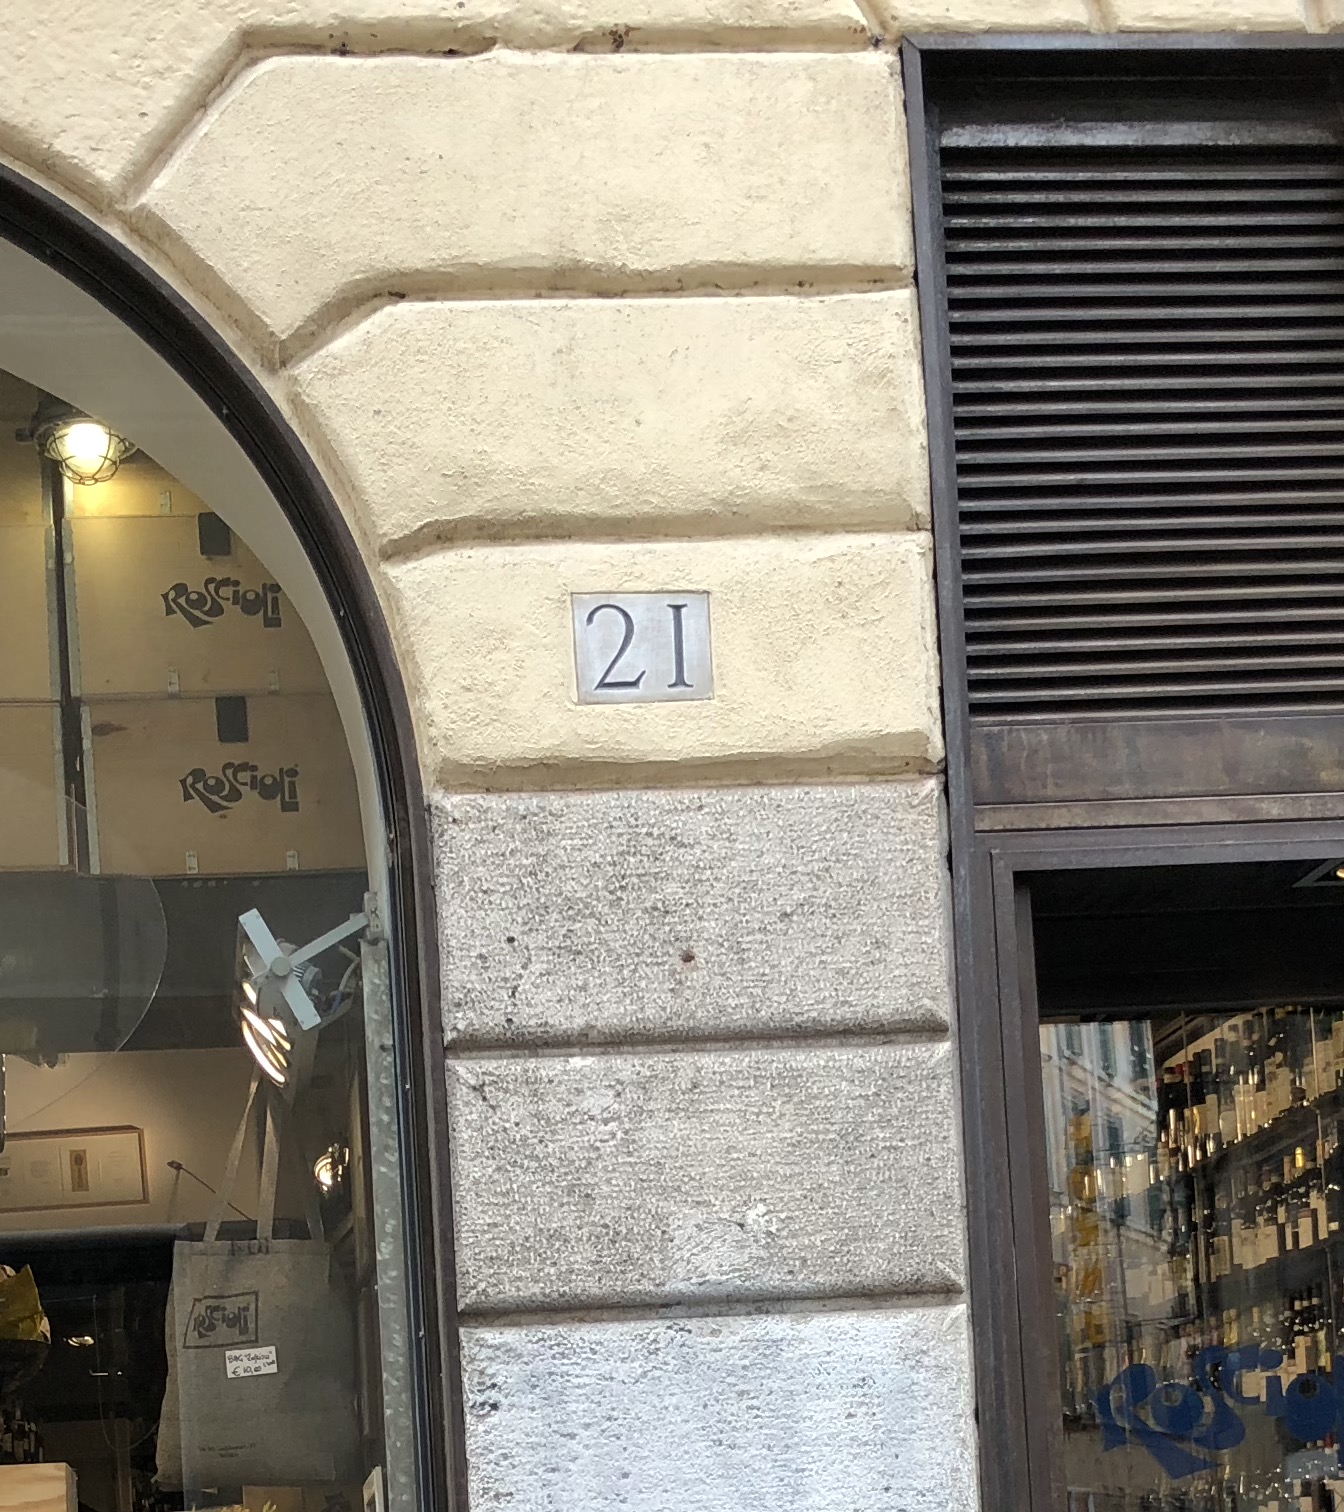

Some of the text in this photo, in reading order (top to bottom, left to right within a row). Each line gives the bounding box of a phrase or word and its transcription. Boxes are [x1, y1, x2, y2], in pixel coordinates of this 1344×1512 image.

[161, 576, 284, 628] Roscioli
[585, 603, 694, 692] 21
[179, 761, 300, 813] Roscioli
